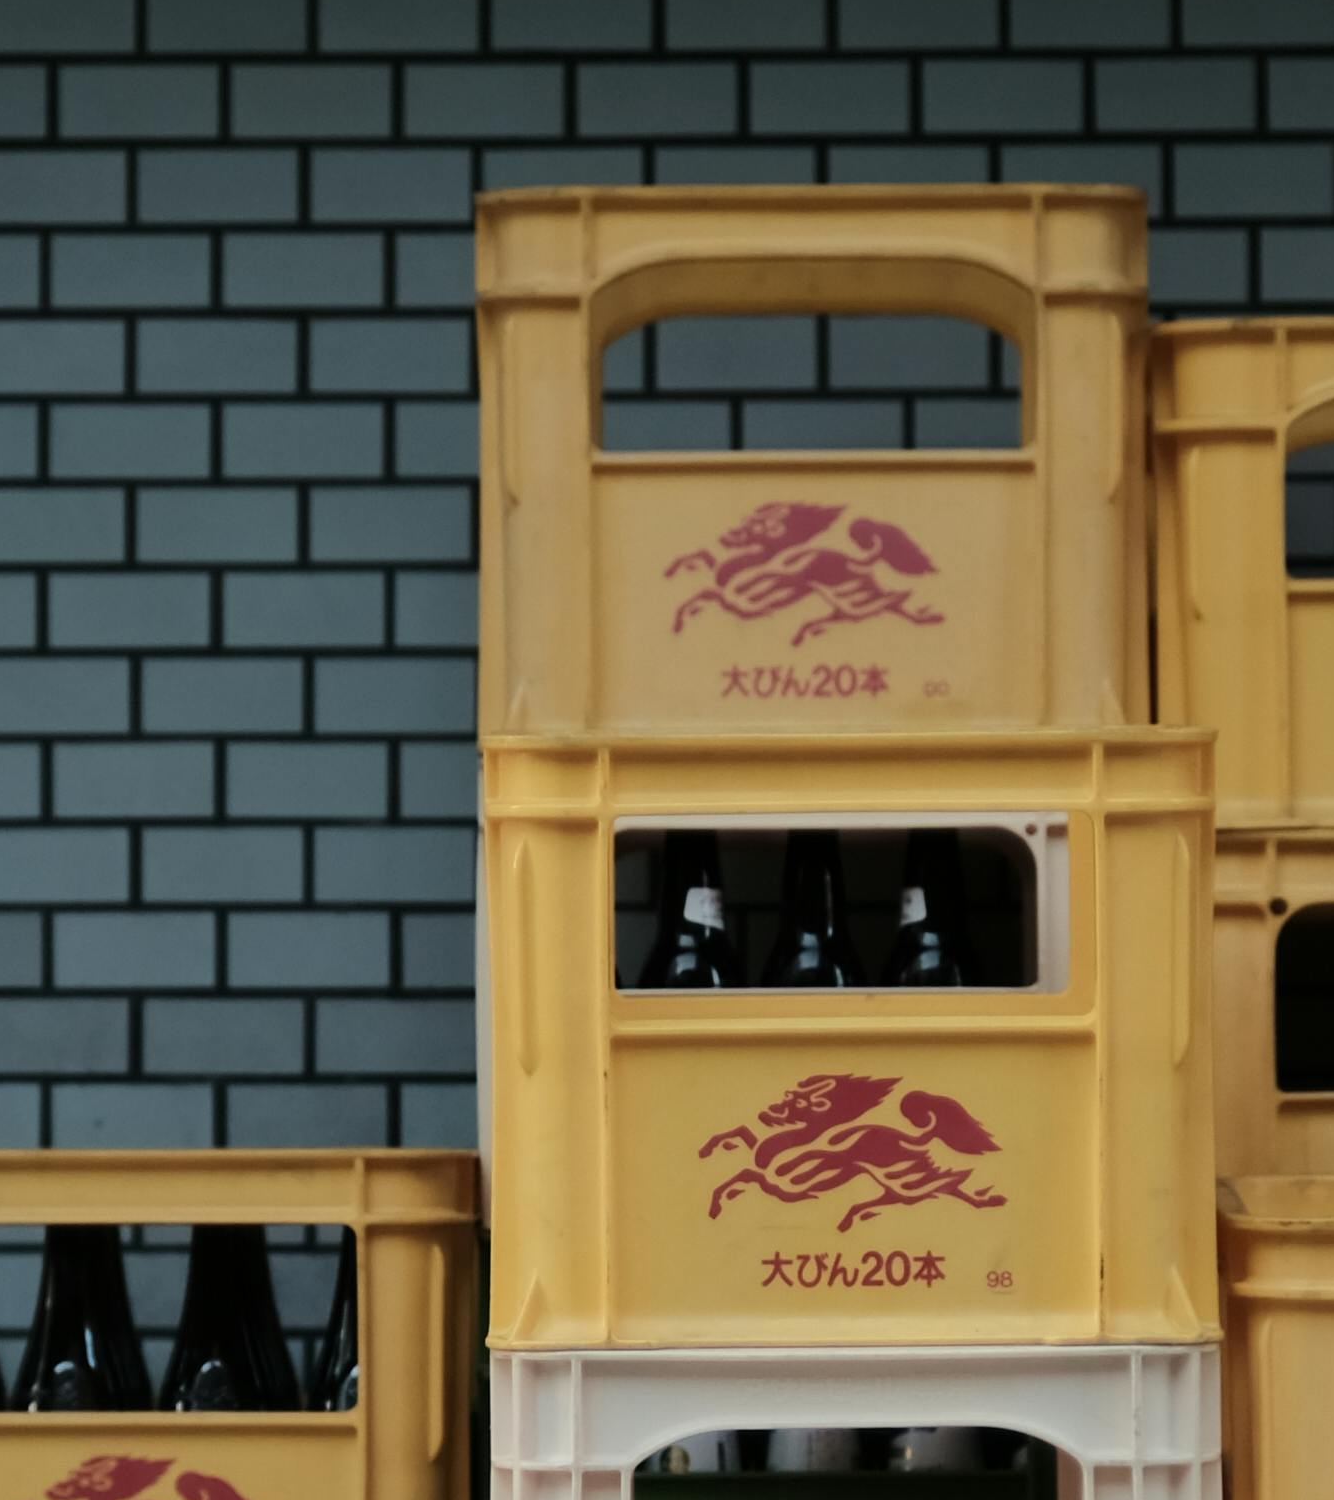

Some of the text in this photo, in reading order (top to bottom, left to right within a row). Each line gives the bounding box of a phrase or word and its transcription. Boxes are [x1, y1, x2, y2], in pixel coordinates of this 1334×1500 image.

[720, 662, 890, 699] 大びん20本
[760, 1249, 946, 1289] 大びん20本
[985, 1269, 1014, 1289] 98
